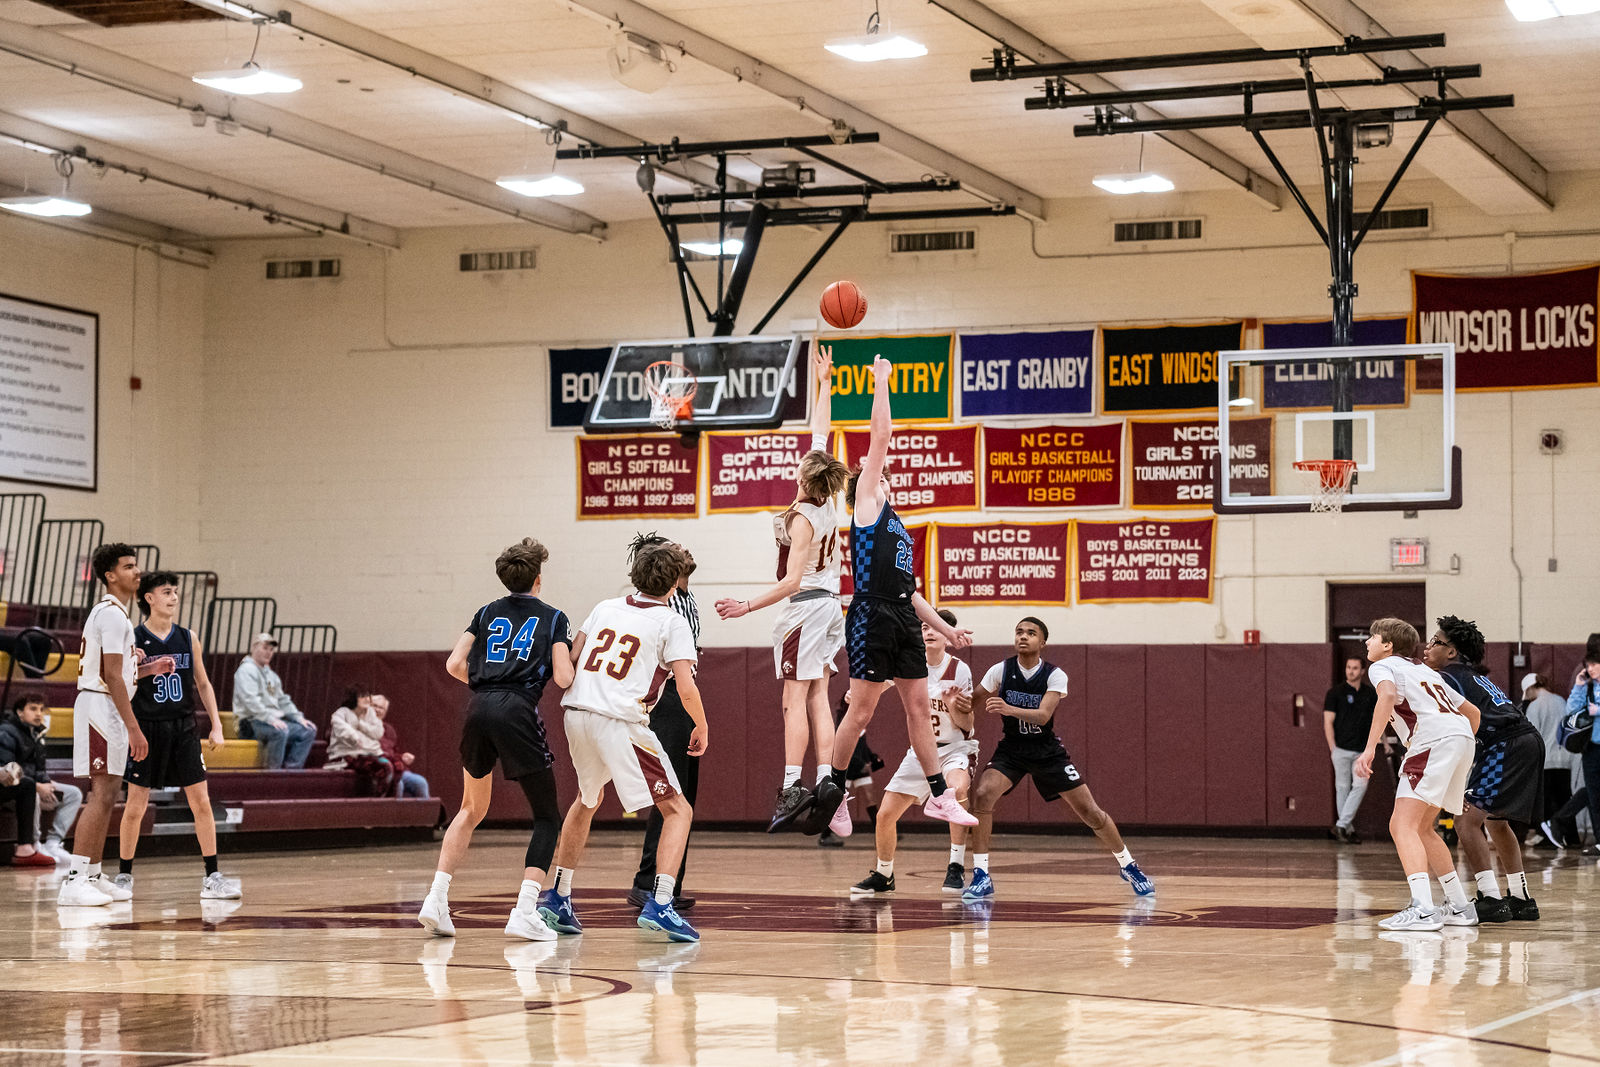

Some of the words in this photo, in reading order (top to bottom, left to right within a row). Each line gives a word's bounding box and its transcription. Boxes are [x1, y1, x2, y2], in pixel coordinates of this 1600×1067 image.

[1420, 309, 1512, 353] WINDSOR
[1520, 303, 1595, 351] LOCKS
[962, 359, 1011, 392] EAST
[1017, 357, 1089, 390] GRANBY
[1108, 353, 1153, 387] EAST
[1161, 351, 1234, 384] WINDSO
[561, 371, 654, 404] BOLTO
[744, 436, 799, 450] NCCC
[1020, 432, 1085, 448] NCCC
[608, 444, 671, 458] NCCC
[722, 450, 801, 467] SOFTBAL
[989, 452, 1026, 466] GIRLS
[1031, 449, 1115, 465] BASKETBALL
[1146, 446, 1193, 461] GIRLS
[587, 461, 622, 475] GIRLS
[627, 459, 692, 474] SOFTBALL
[719, 466, 799, 482] CHAMPIO
[1134, 466, 1204, 481] TOURNAMENT
[918, 470, 974, 487] CHAMPIONS
[991, 470, 1043, 484] PLAYOFF
[1048, 468, 1113, 483] CHAMPIONS
[604, 477, 674, 492] CHAMPIONS
[711, 484, 738, 496] 2000
[613, 494, 639, 507] 1994
[643, 493, 669, 506] 1997
[671, 493, 696, 506] 1999
[889, 490, 935, 506] 1999
[1027, 487, 1076, 502] 1986
[972, 529, 1031, 544] NCCC
[1118, 525, 1171, 538] NCCC
[1086, 540, 1118, 552] BOYS
[1124, 539, 1202, 551] BASKETBALL
[943, 548, 975, 562] BOYS
[980, 547, 1061, 562] BASKETBALL
[1090, 553, 1199, 568] CHAMPIONS
[948, 565, 993, 580] PLAYOFF
[998, 564, 1056, 579] CHAMPIONS
[1080, 570, 1106, 582] 1995
[1112, 569, 1139, 581] 2001
[1145, 568, 1171, 580] 2011
[1178, 568, 1207, 580] 2023
[969, 584, 995, 596] 1996
[1000, 583, 1026, 596] 2001
[486, 616, 539, 663] 24
[584, 628, 641, 681] 23
[153, 672, 183, 703] 30
